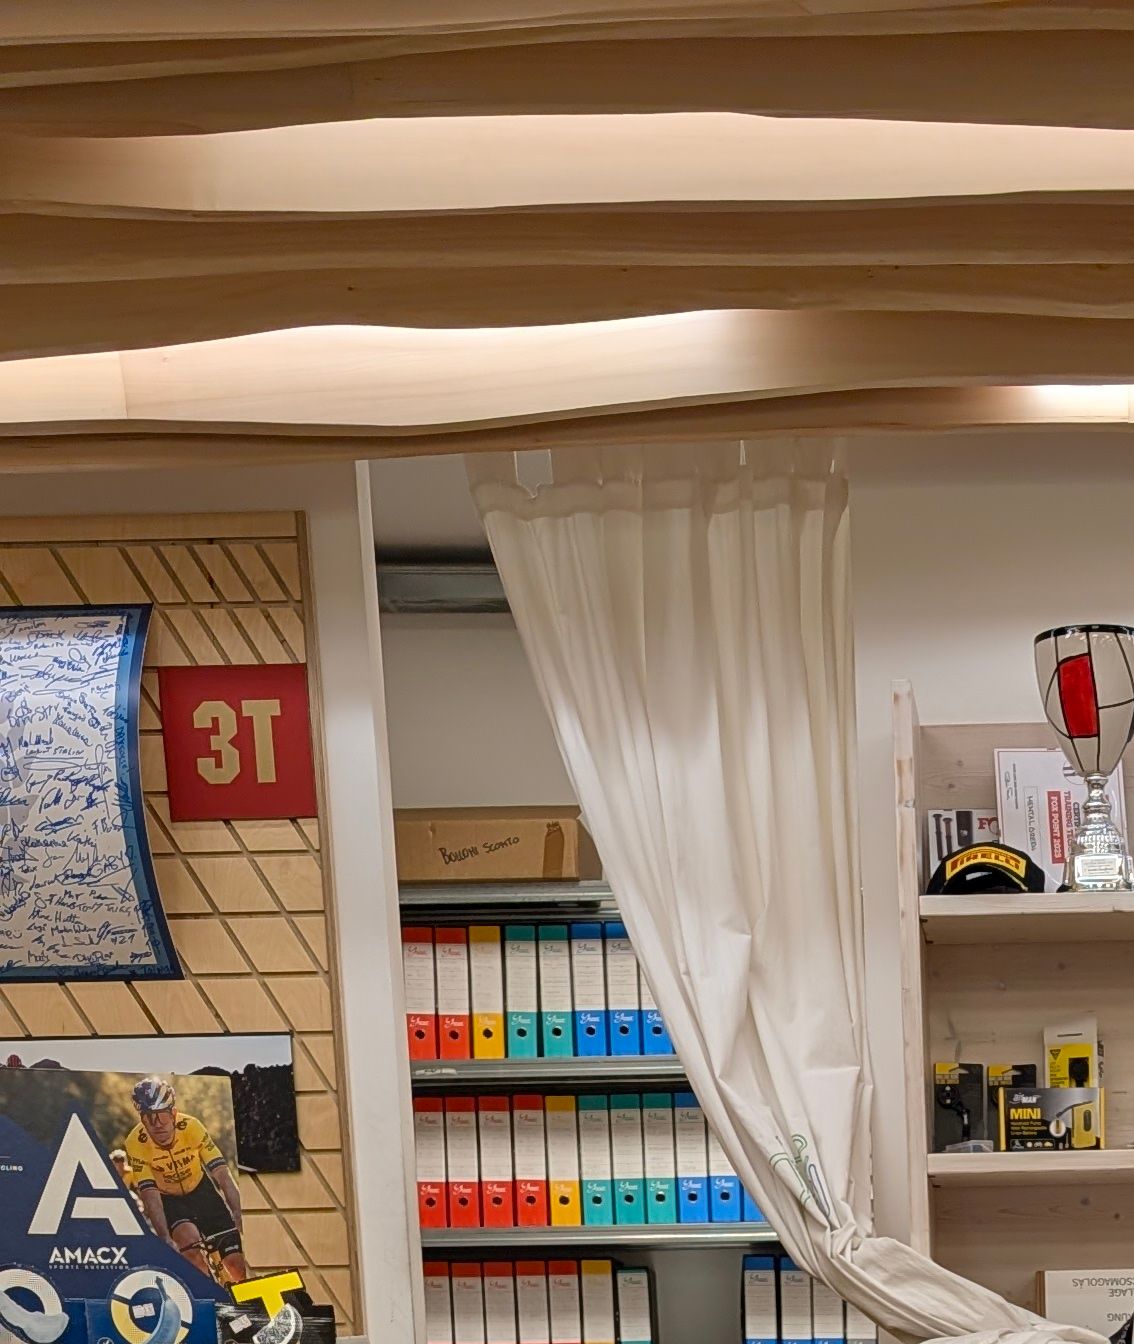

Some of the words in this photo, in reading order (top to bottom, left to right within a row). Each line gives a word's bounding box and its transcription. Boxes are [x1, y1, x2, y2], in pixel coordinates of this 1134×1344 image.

[193, 699, 281, 785] 3T
[1050, 796, 1058, 812] FOX
[483, 836, 520, 853] SCONTO
[1010, 1107, 1041, 1120] MINI
[50, 1247, 128, 1265] AMACX
